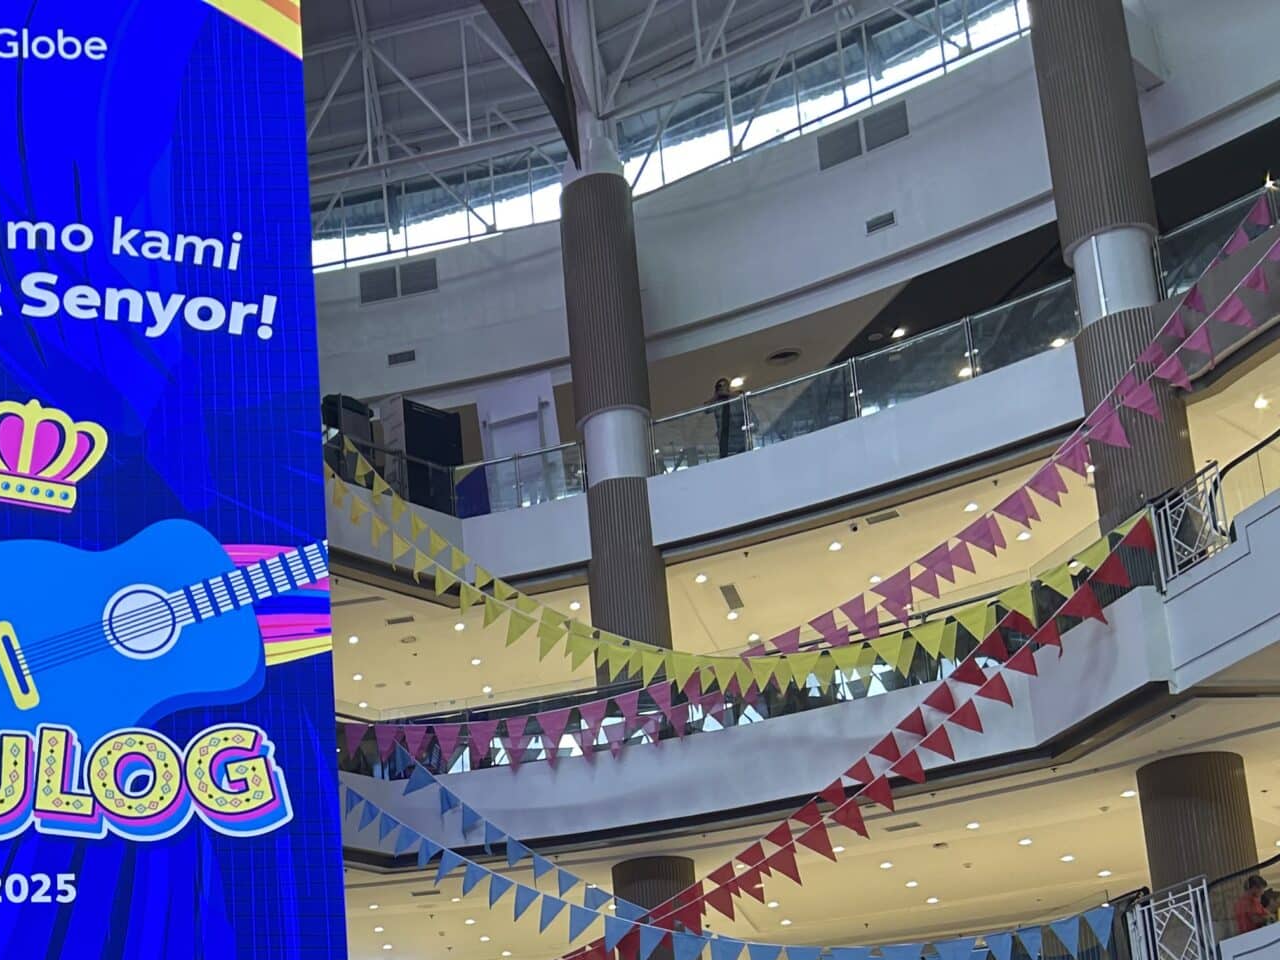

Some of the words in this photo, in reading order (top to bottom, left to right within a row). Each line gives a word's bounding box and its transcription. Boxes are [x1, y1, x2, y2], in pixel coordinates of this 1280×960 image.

[6, 218, 94, 255] mo
[111, 216, 243, 271] kami
[19, 271, 277, 340] Senyor!
